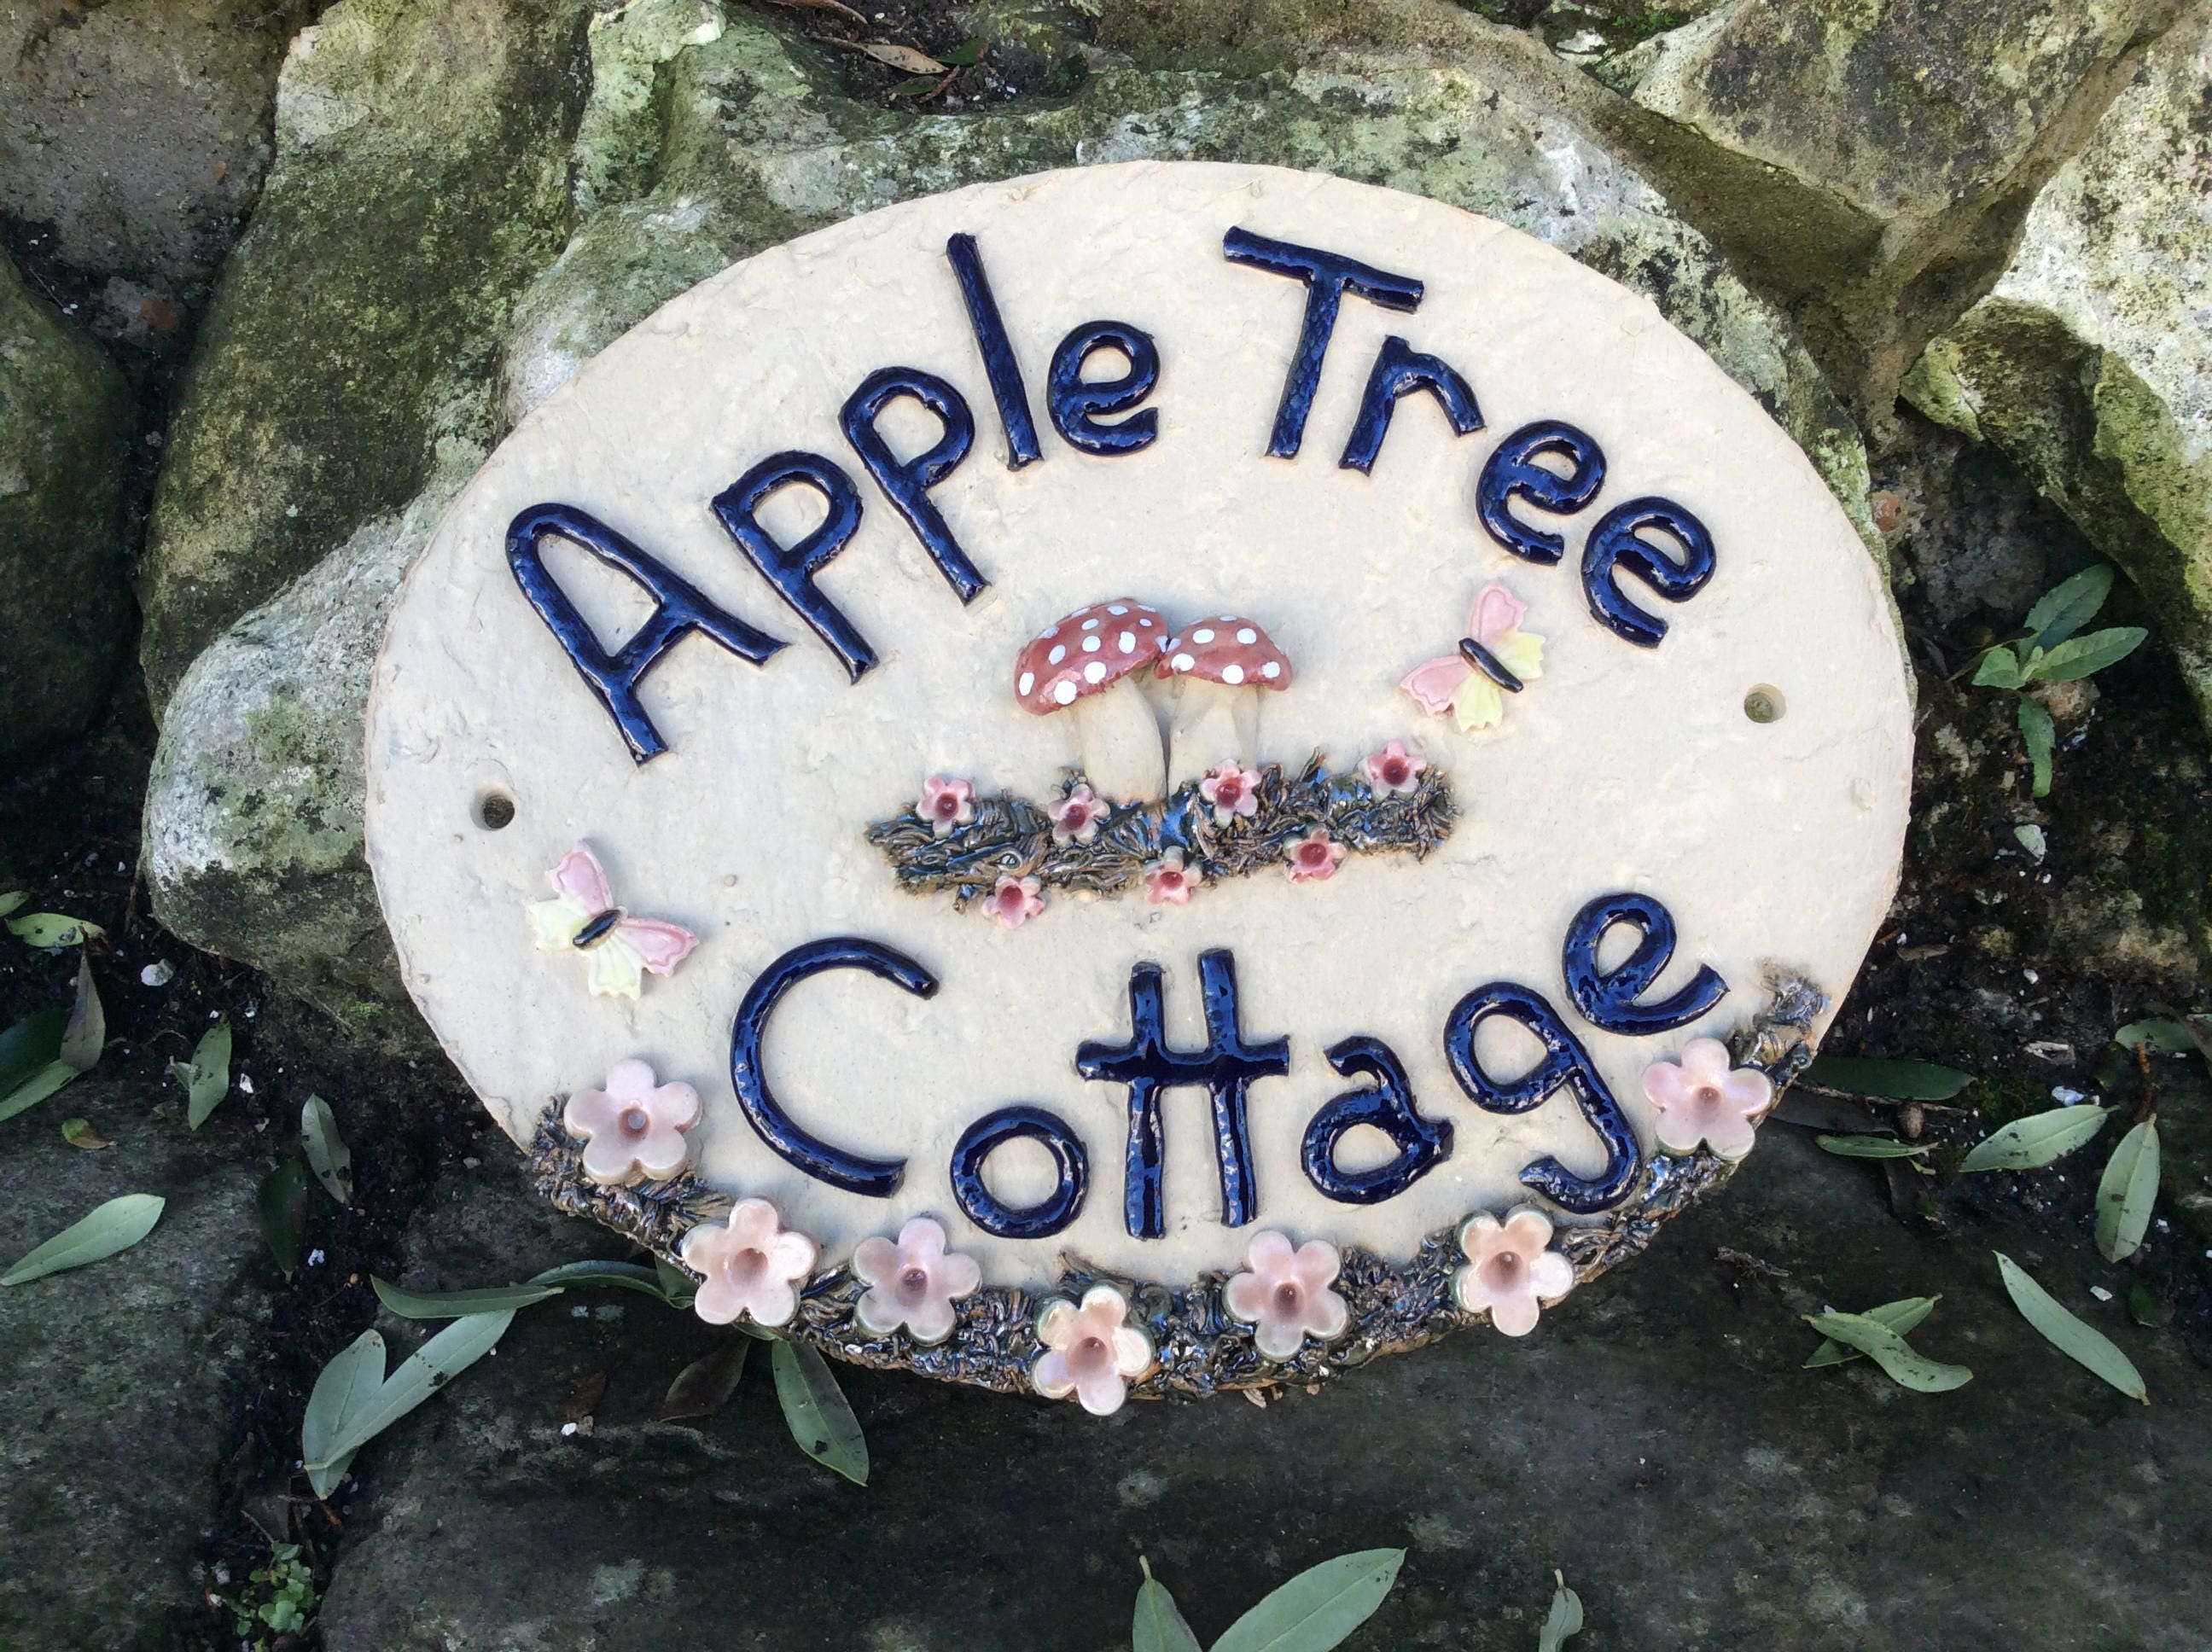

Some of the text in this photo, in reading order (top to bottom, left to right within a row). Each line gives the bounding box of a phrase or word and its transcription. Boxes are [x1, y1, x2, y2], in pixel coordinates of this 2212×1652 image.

[505, 226, 1716, 767] Apple Tree
[731, 893, 1730, 1241] Cottage
